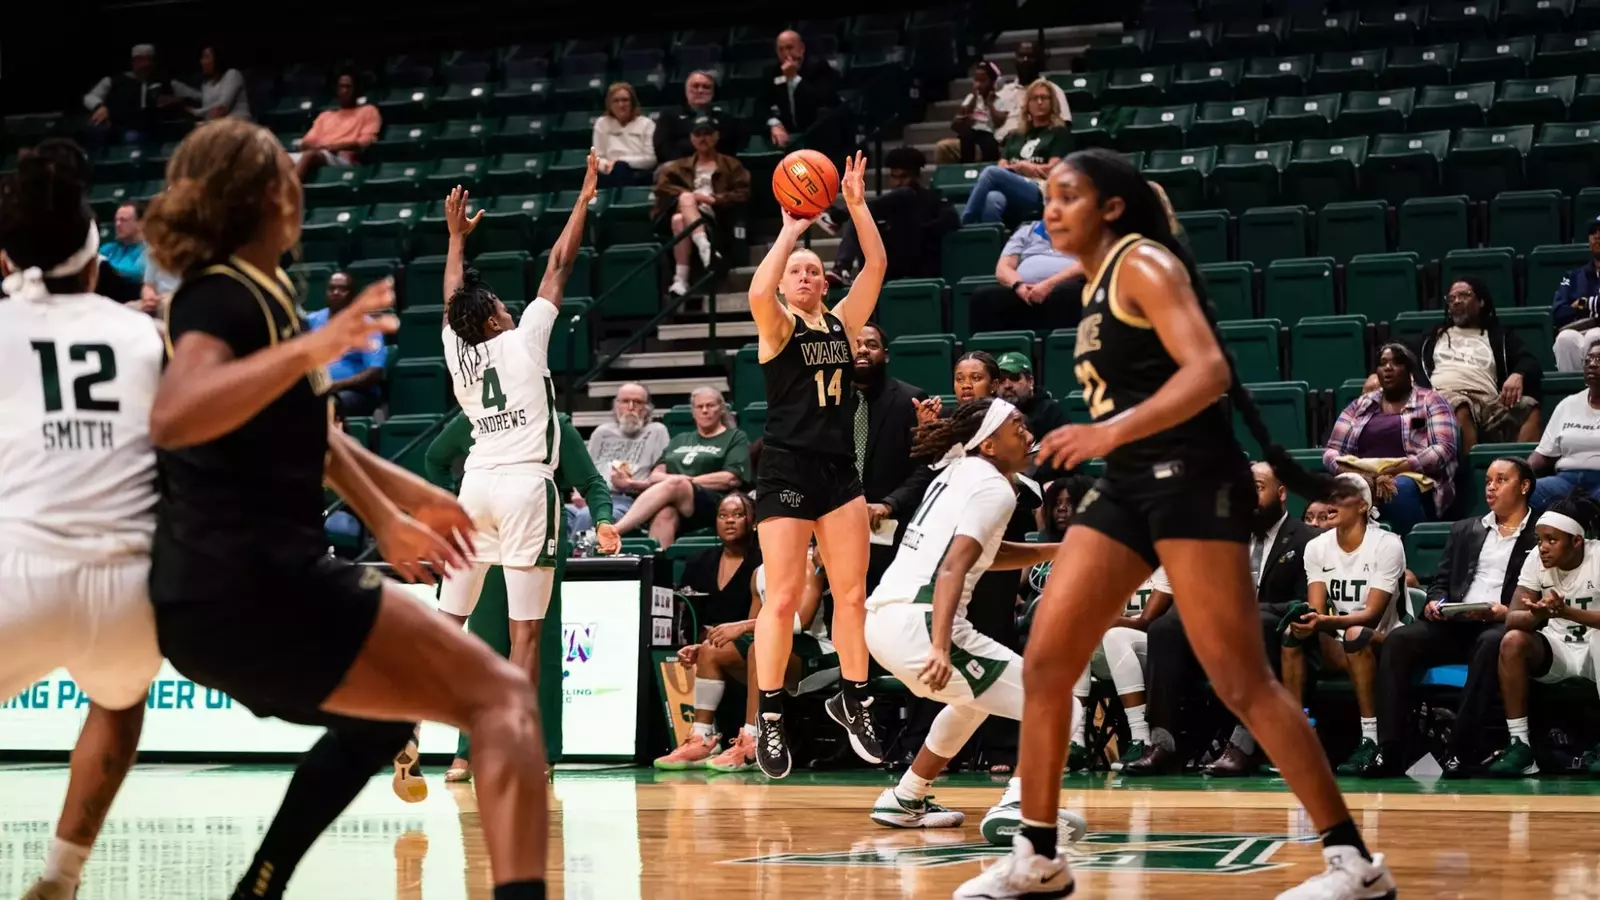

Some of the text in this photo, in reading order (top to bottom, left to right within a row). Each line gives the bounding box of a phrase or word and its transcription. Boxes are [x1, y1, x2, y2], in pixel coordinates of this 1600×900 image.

[801, 340, 849, 366] WAKE
[30, 340, 120, 412] 12
[482, 367, 507, 412] 4
[814, 368, 843, 407] 14
[42, 420, 114, 450] SMITH
[476, 409, 527, 435] ANDREWS
[1330, 579, 1367, 602] CLT
